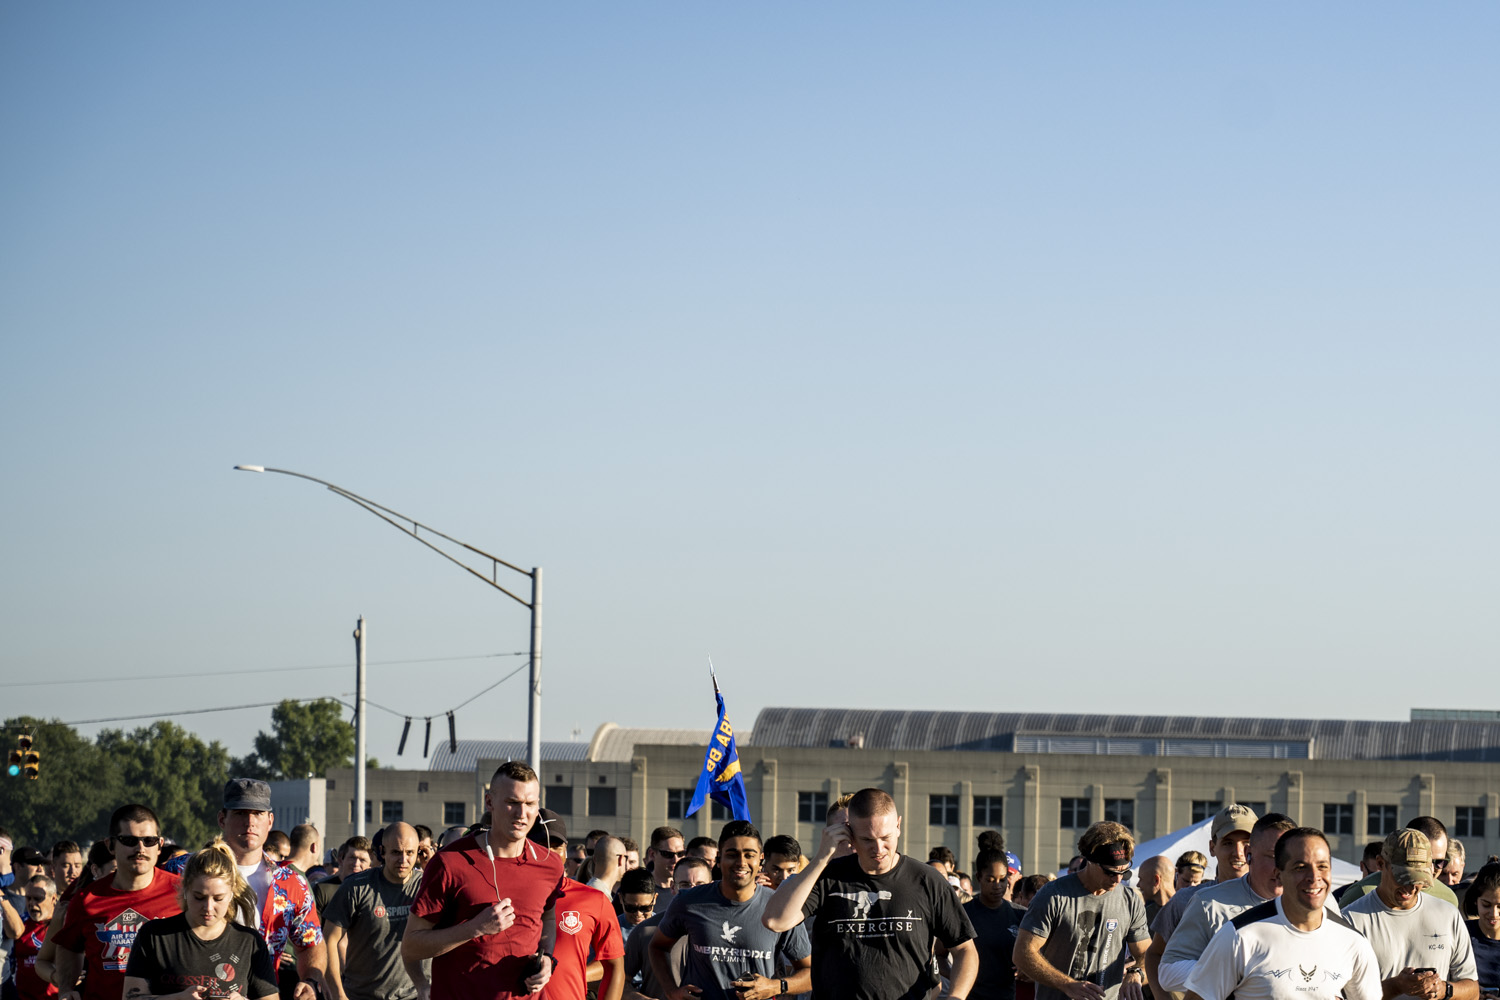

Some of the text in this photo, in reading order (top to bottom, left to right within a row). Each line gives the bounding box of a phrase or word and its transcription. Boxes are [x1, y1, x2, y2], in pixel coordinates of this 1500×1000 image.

[706, 747, 723, 773] 88
[386, 905, 411, 917] SPART
[837, 921, 913, 933] EXERCISE
[712, 955, 746, 963] ALUMNI
